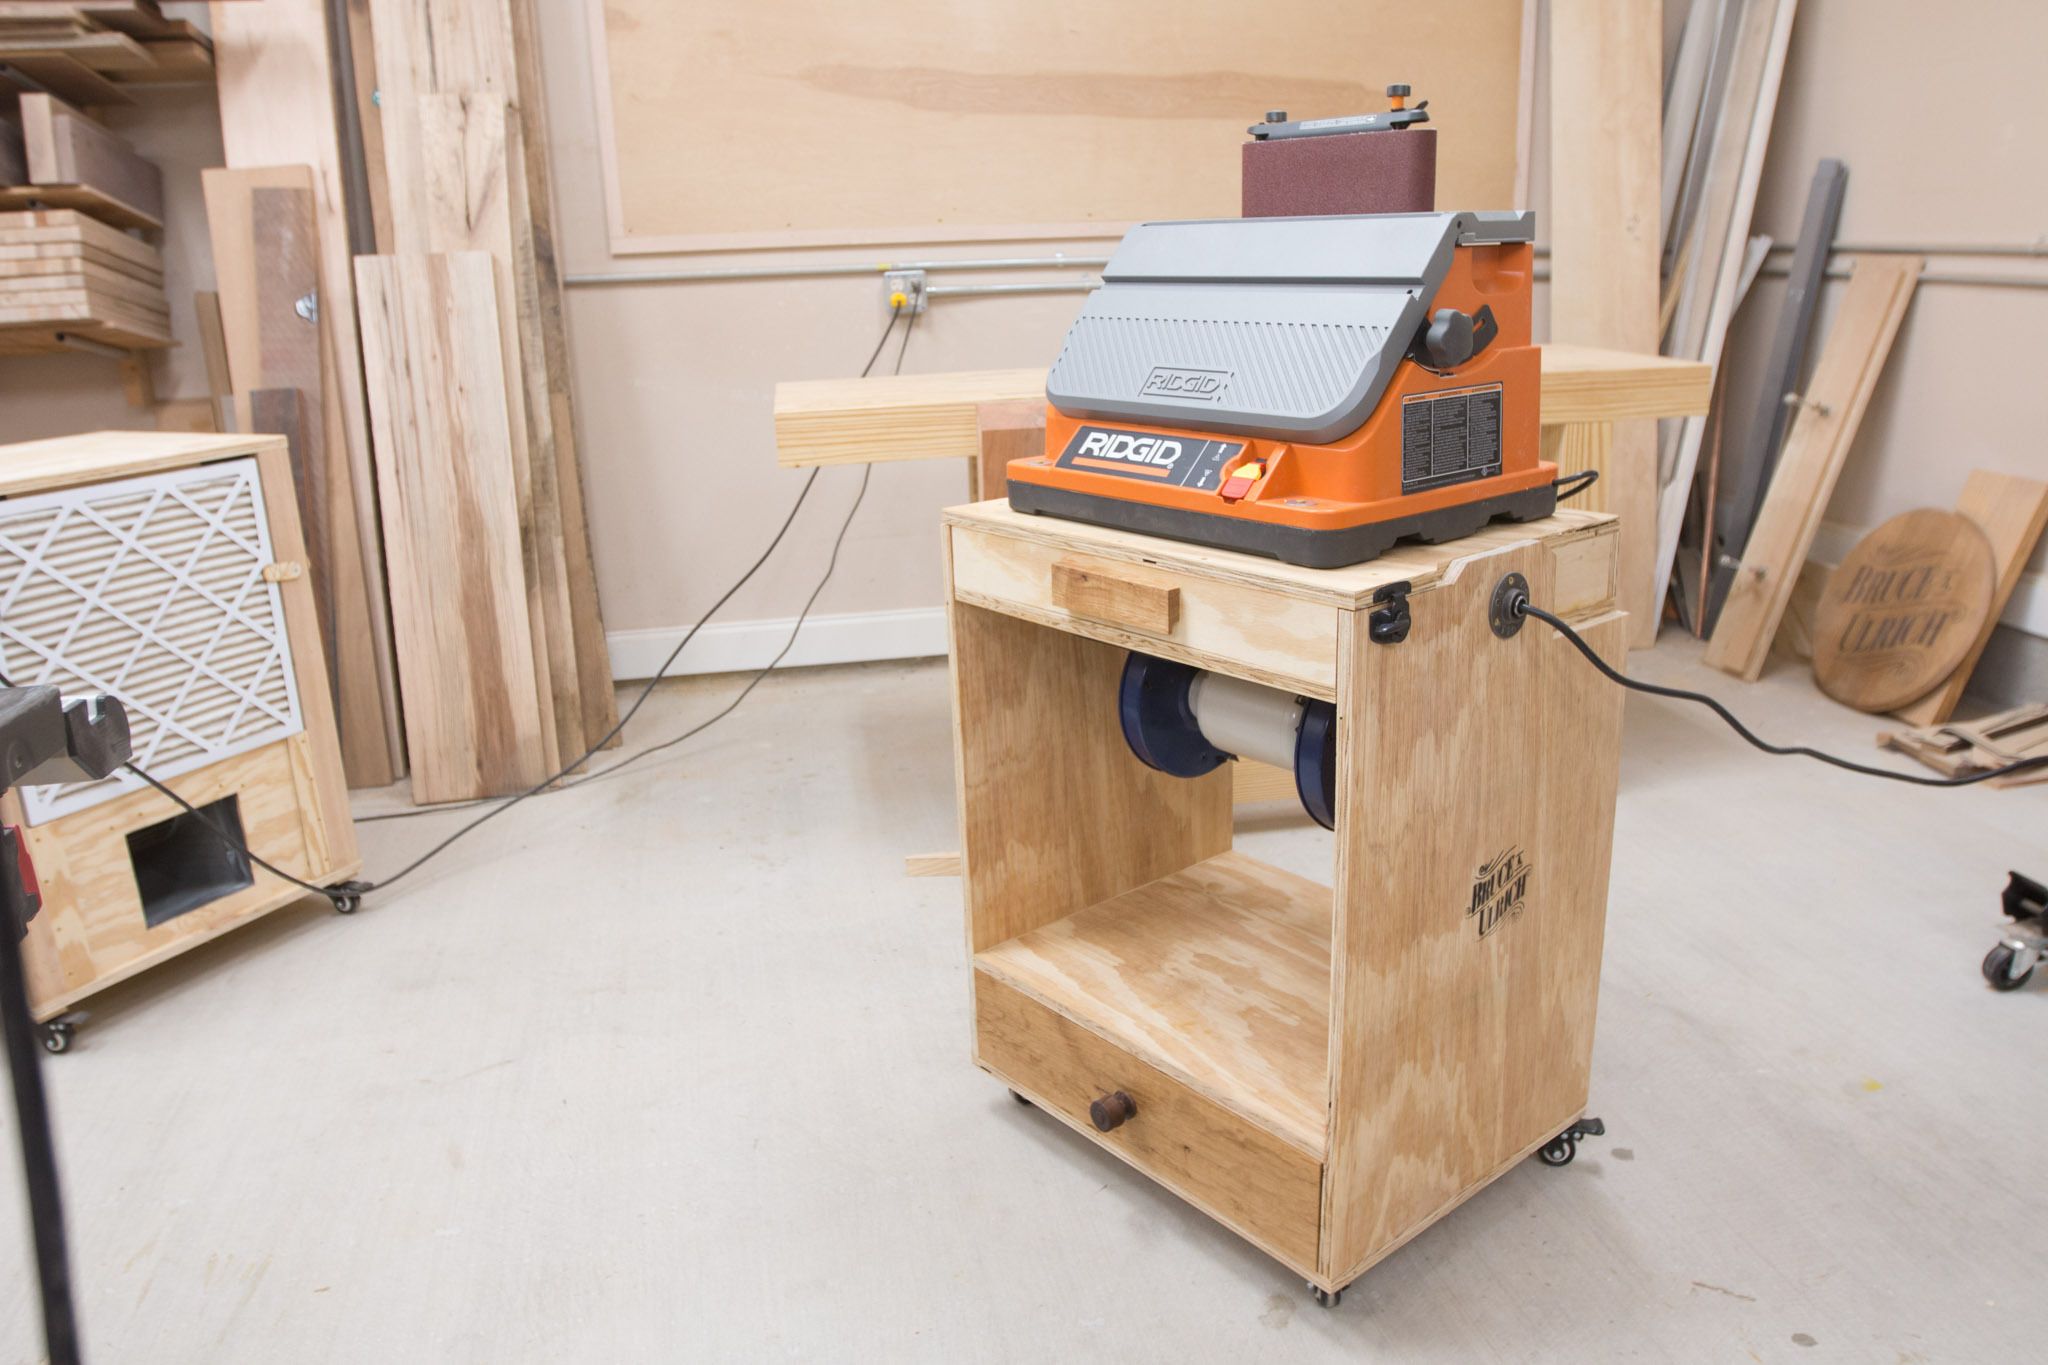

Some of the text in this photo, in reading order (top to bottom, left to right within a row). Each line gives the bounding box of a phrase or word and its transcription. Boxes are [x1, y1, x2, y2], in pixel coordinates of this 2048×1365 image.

[1147, 373, 1221, 394] RIDGID
[1078, 431, 1182, 465] RIDGID
[1479, 874, 1526, 936] ULRICH
